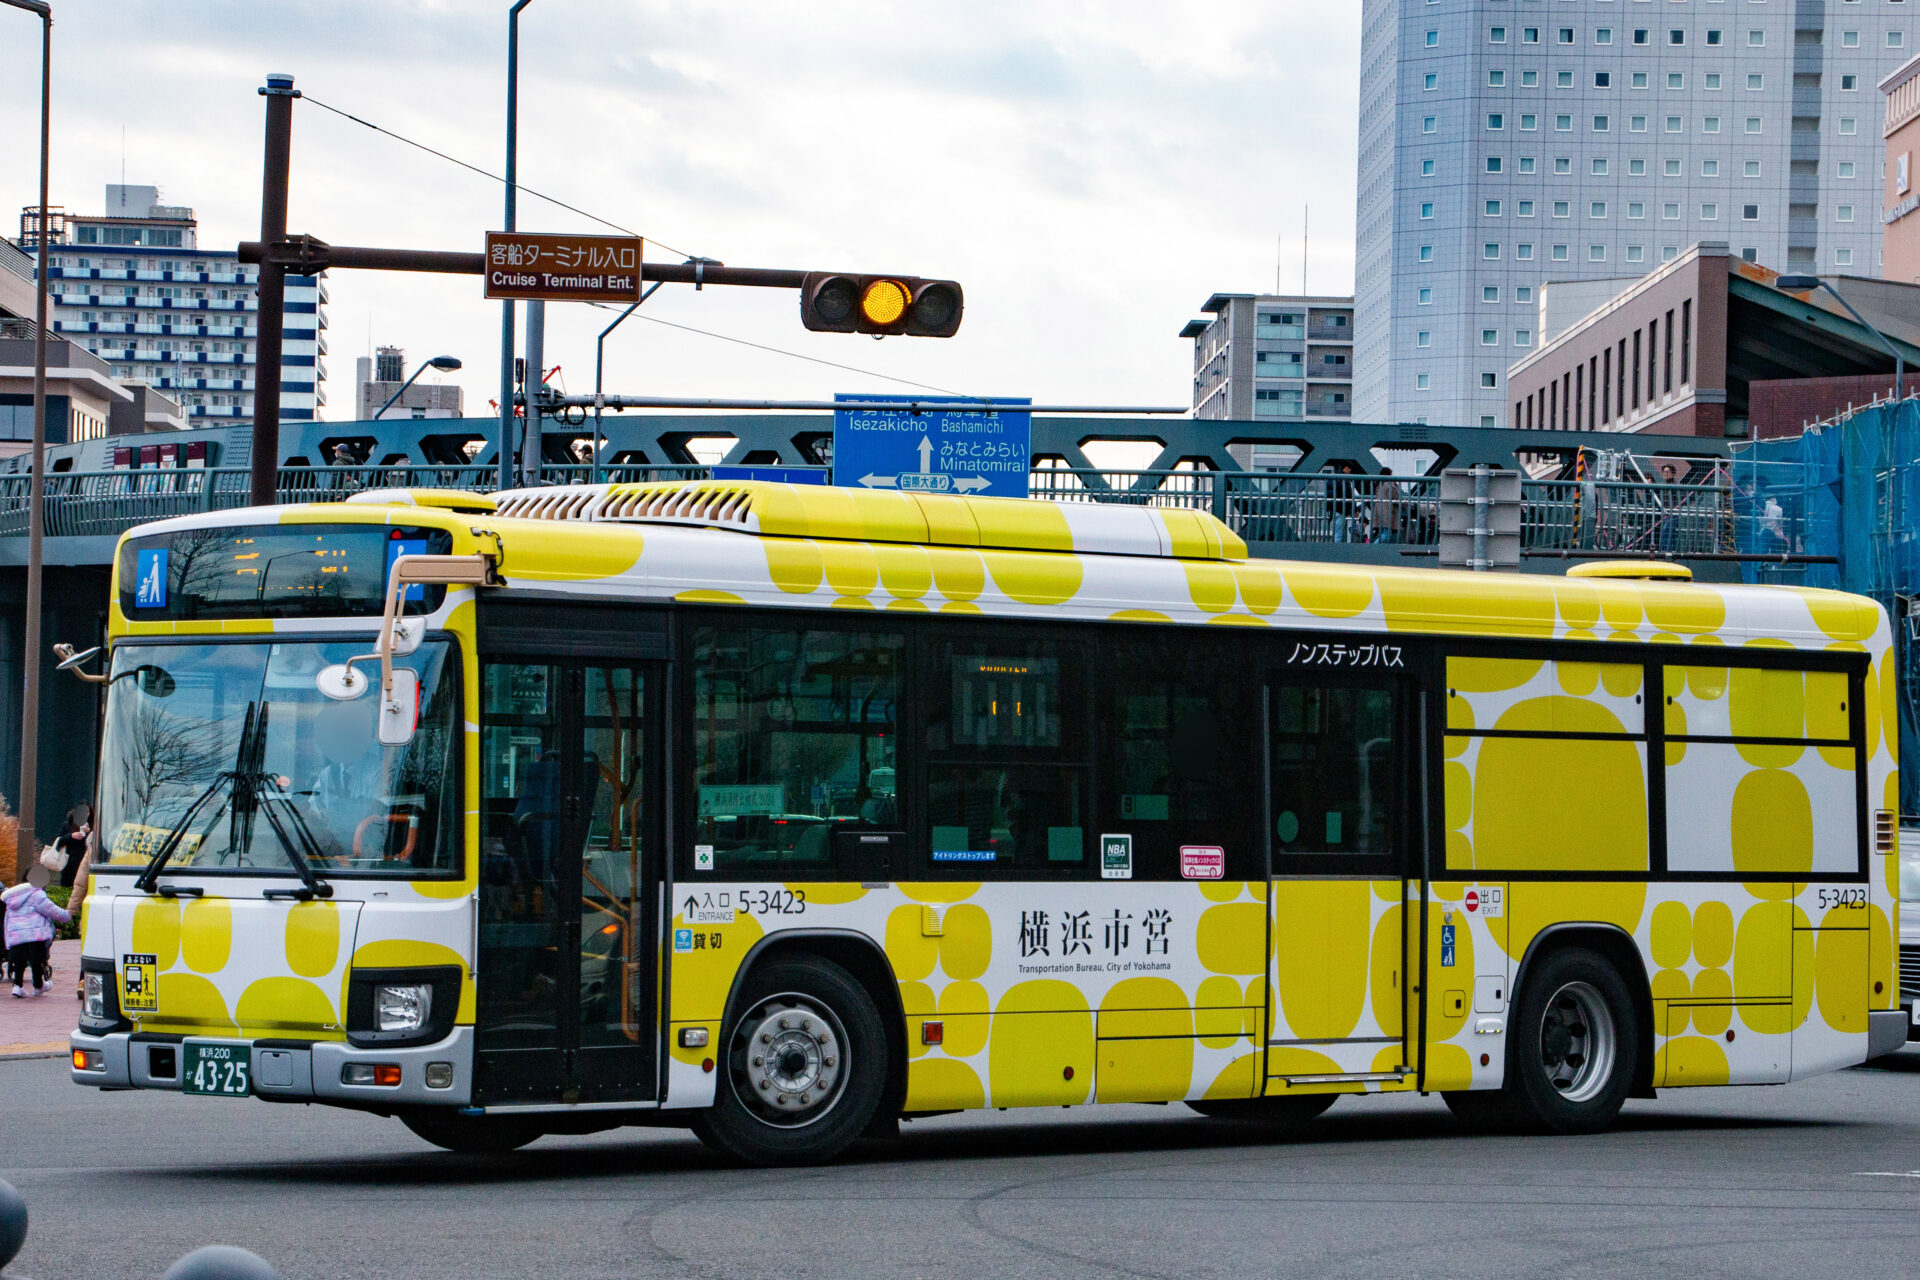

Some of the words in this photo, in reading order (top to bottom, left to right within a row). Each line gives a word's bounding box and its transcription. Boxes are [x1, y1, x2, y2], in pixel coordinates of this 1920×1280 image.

[491, 243, 635, 268] 客船ターミナル入口
[492, 271, 537, 286] Cruise
[542, 273, 603, 288] Terminal
[607, 275, 634, 289] Ent.
[849, 416, 928, 432] Isezakicho
[941, 419, 1004, 434] Bashamichi
[940, 441, 1025, 457] みなとみらい
[940, 457, 1025, 472] Minatomirai
[902, 476, 947, 488] 国際大通り
[1287, 643, 1404, 667] ノンステップバス
[1107, 844, 1126, 857] NBA
[702, 892, 730, 909] 入口
[739, 890, 806, 914] 5-3423
[1480, 889, 1501, 904] 出口
[1818, 889, 1866, 909] 5-3423
[698, 911, 733, 921] ENTRANCE
[1482, 907, 1498, 915] EXIT
[693, 932, 722, 950] 貸切
[1017, 908, 1173, 958] 横浜市営
[1018, 964, 1074, 975] Transportation
[1076, 963, 1104, 973] Bureau,
[1106, 962, 1121, 973] City
[1123, 962, 1132, 971] of
[1134, 962, 1171, 971] Yokohama
[185, 1070, 193, 1080] か
[194, 1060, 247, 1093] 43-25
